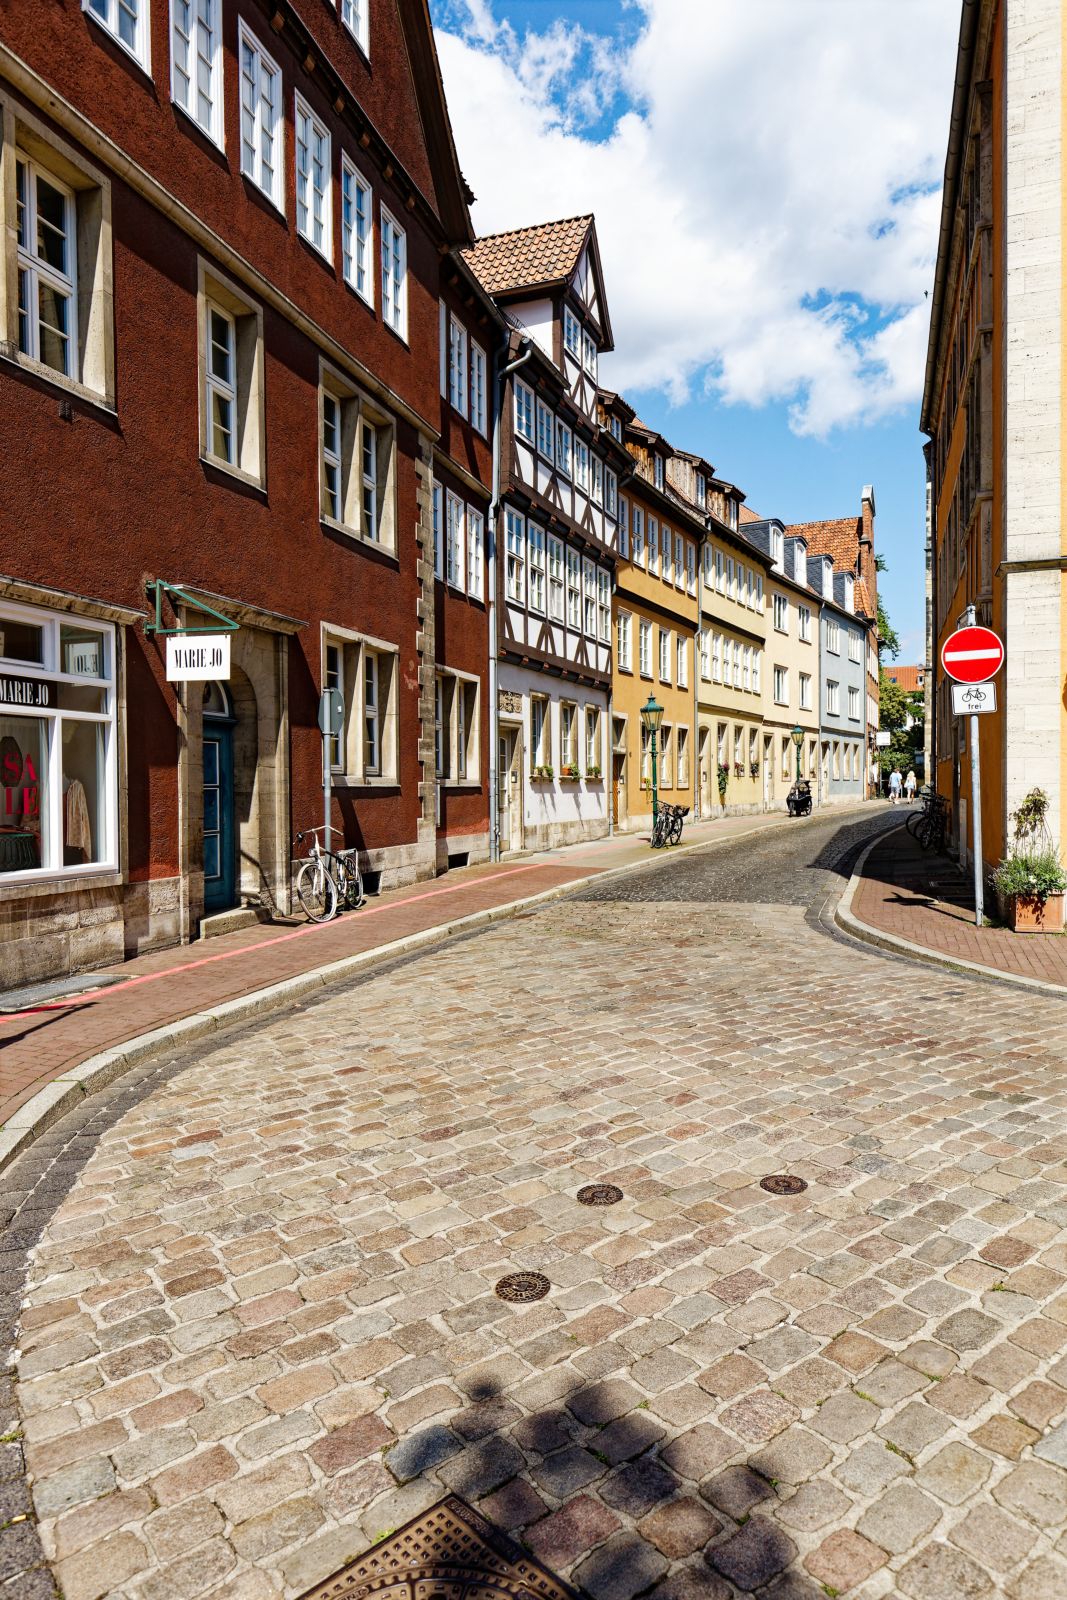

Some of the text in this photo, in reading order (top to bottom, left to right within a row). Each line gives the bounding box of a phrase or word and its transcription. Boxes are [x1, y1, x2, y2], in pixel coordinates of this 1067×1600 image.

[174, 647, 223, 669] MARIE JO
[0, 679, 49, 706] MARIE JO
[3, 751, 37, 782] SA
[5, 786, 39, 816] LE
